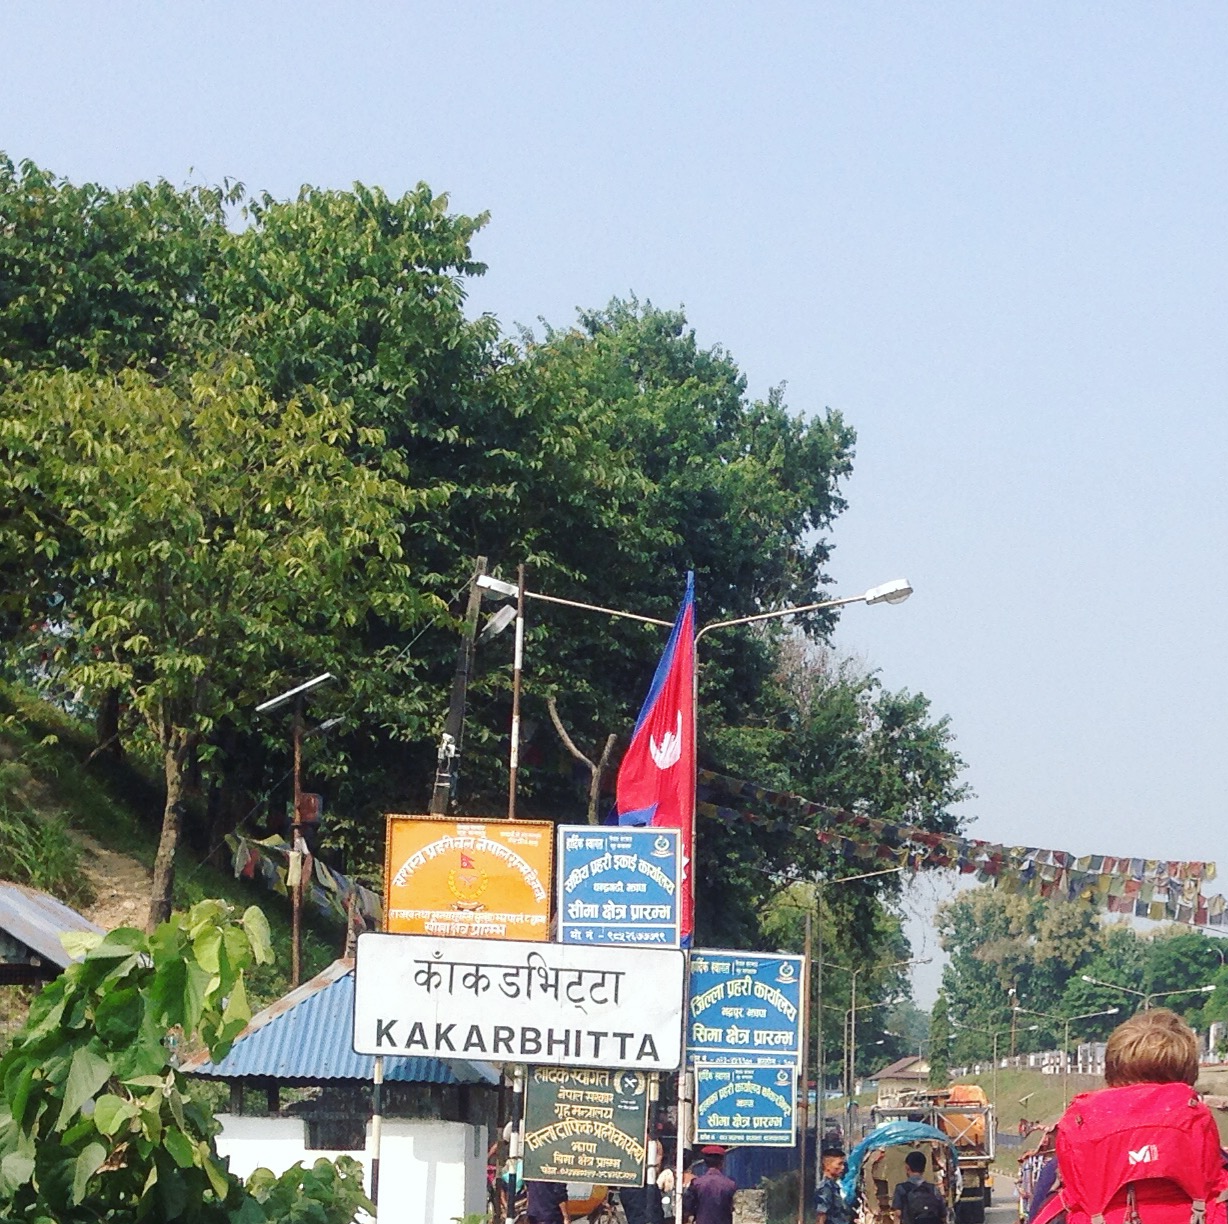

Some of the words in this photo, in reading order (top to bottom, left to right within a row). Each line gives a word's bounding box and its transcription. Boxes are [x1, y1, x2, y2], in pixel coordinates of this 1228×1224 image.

[590, 852, 612, 877] प्रहरी
[568, 899, 600, 919] सीमा
[602, 899, 627, 920] क्षेत्र
[630, 904, 672, 920] प्रारम्भ
[413, 950, 626, 1014] काँकडभिट्टा
[690, 982, 725, 1018] जिल्ला
[726, 974, 753, 998] प्रहरी
[754, 980, 797, 1022] कार्यालय
[376, 1018, 661, 1062] KAKARBHITTA
[693, 1022, 723, 1043] सिमा
[726, 1024, 750, 1045] क्षेत्र
[754, 1030, 795, 1046] प्रारम्भ
